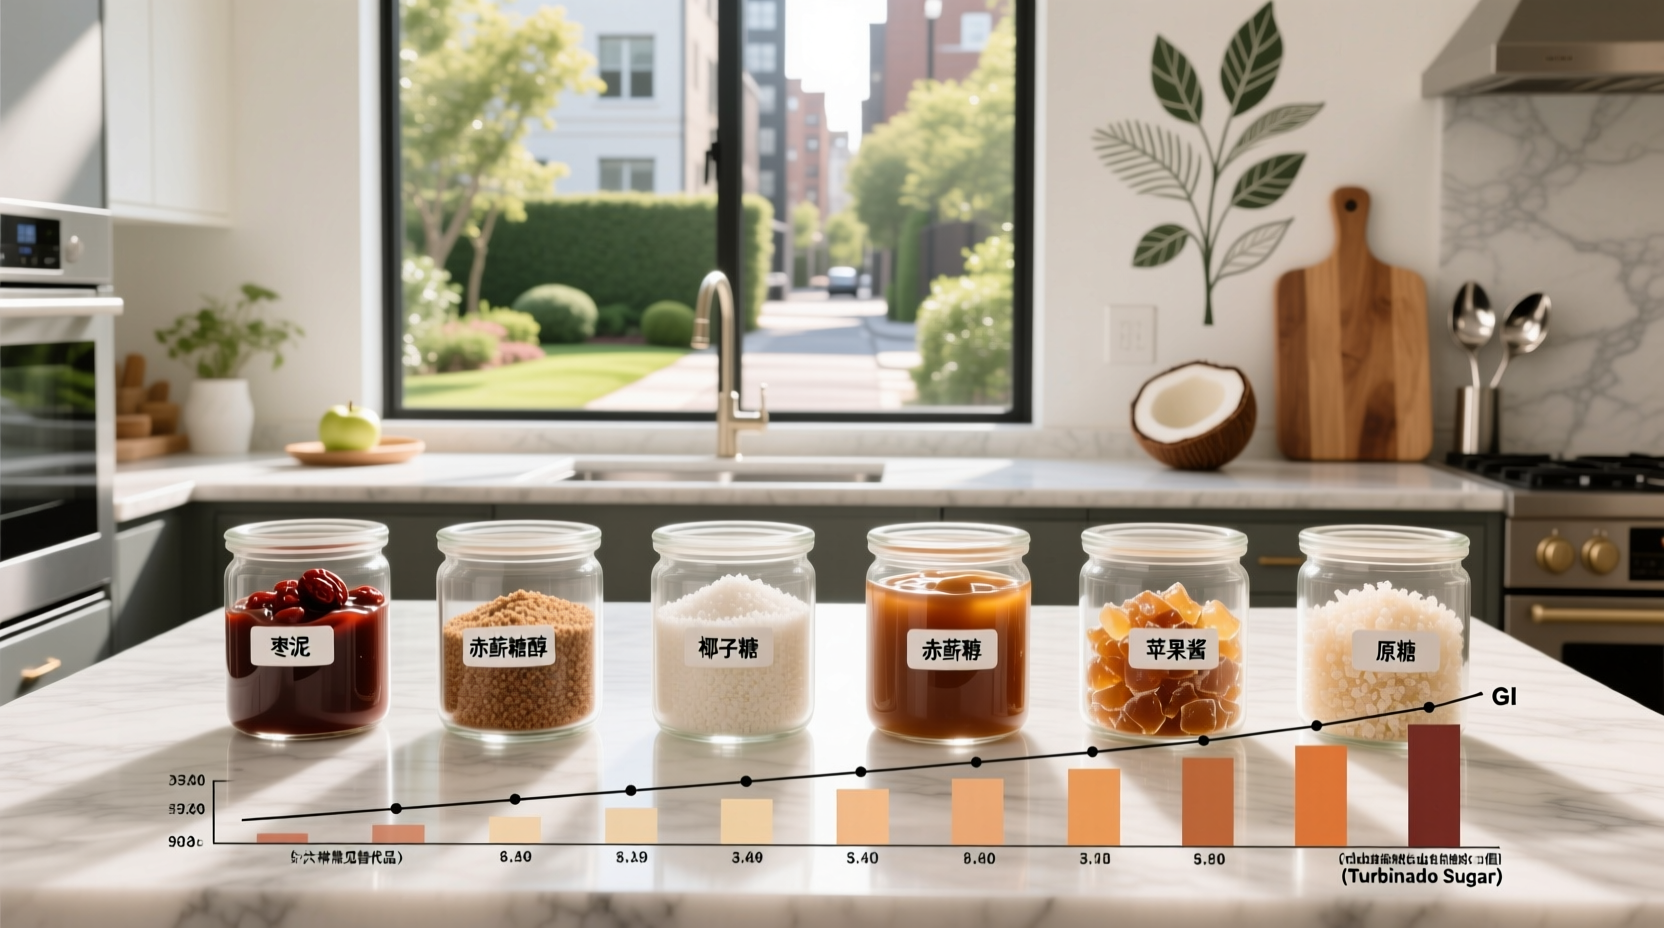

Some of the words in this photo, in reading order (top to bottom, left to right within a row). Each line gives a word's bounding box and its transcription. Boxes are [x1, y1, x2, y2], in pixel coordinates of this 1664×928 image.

[270, 635, 311, 658] 枣泥
[698, 635, 759, 660] 椰子糖
[1146, 637, 1207, 662] 苹果酱
[1375, 639, 1416, 663] 原糖
